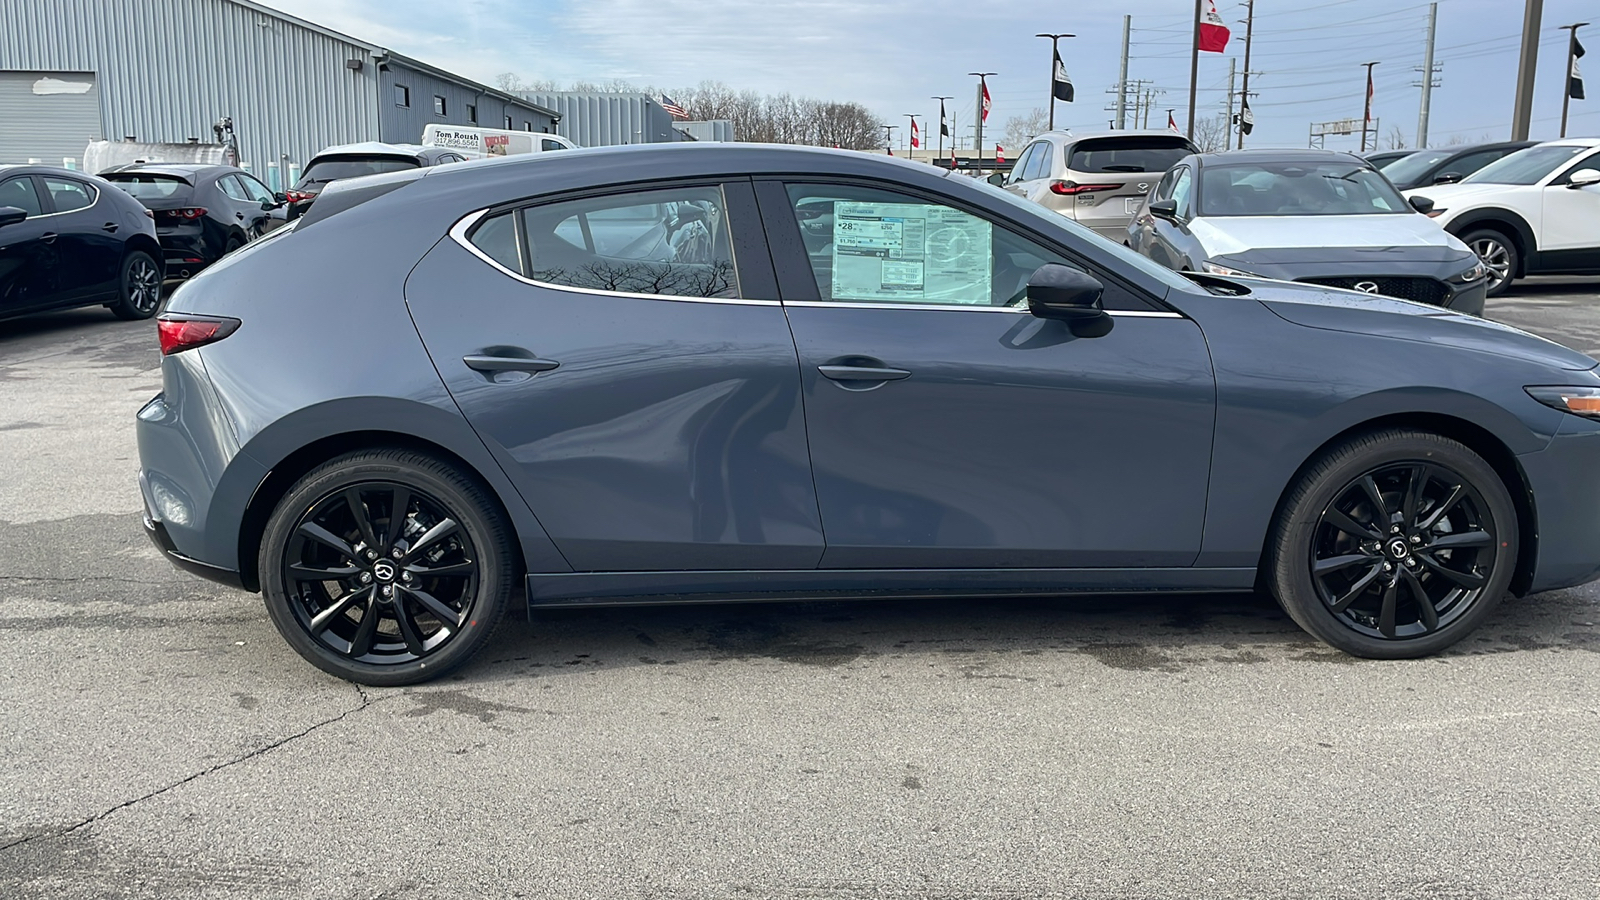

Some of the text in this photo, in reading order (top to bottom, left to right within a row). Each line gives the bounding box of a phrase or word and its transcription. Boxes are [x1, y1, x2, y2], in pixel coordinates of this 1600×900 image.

[435, 130, 479, 140] Tom Roush
[842, 222, 853, 230] 28
